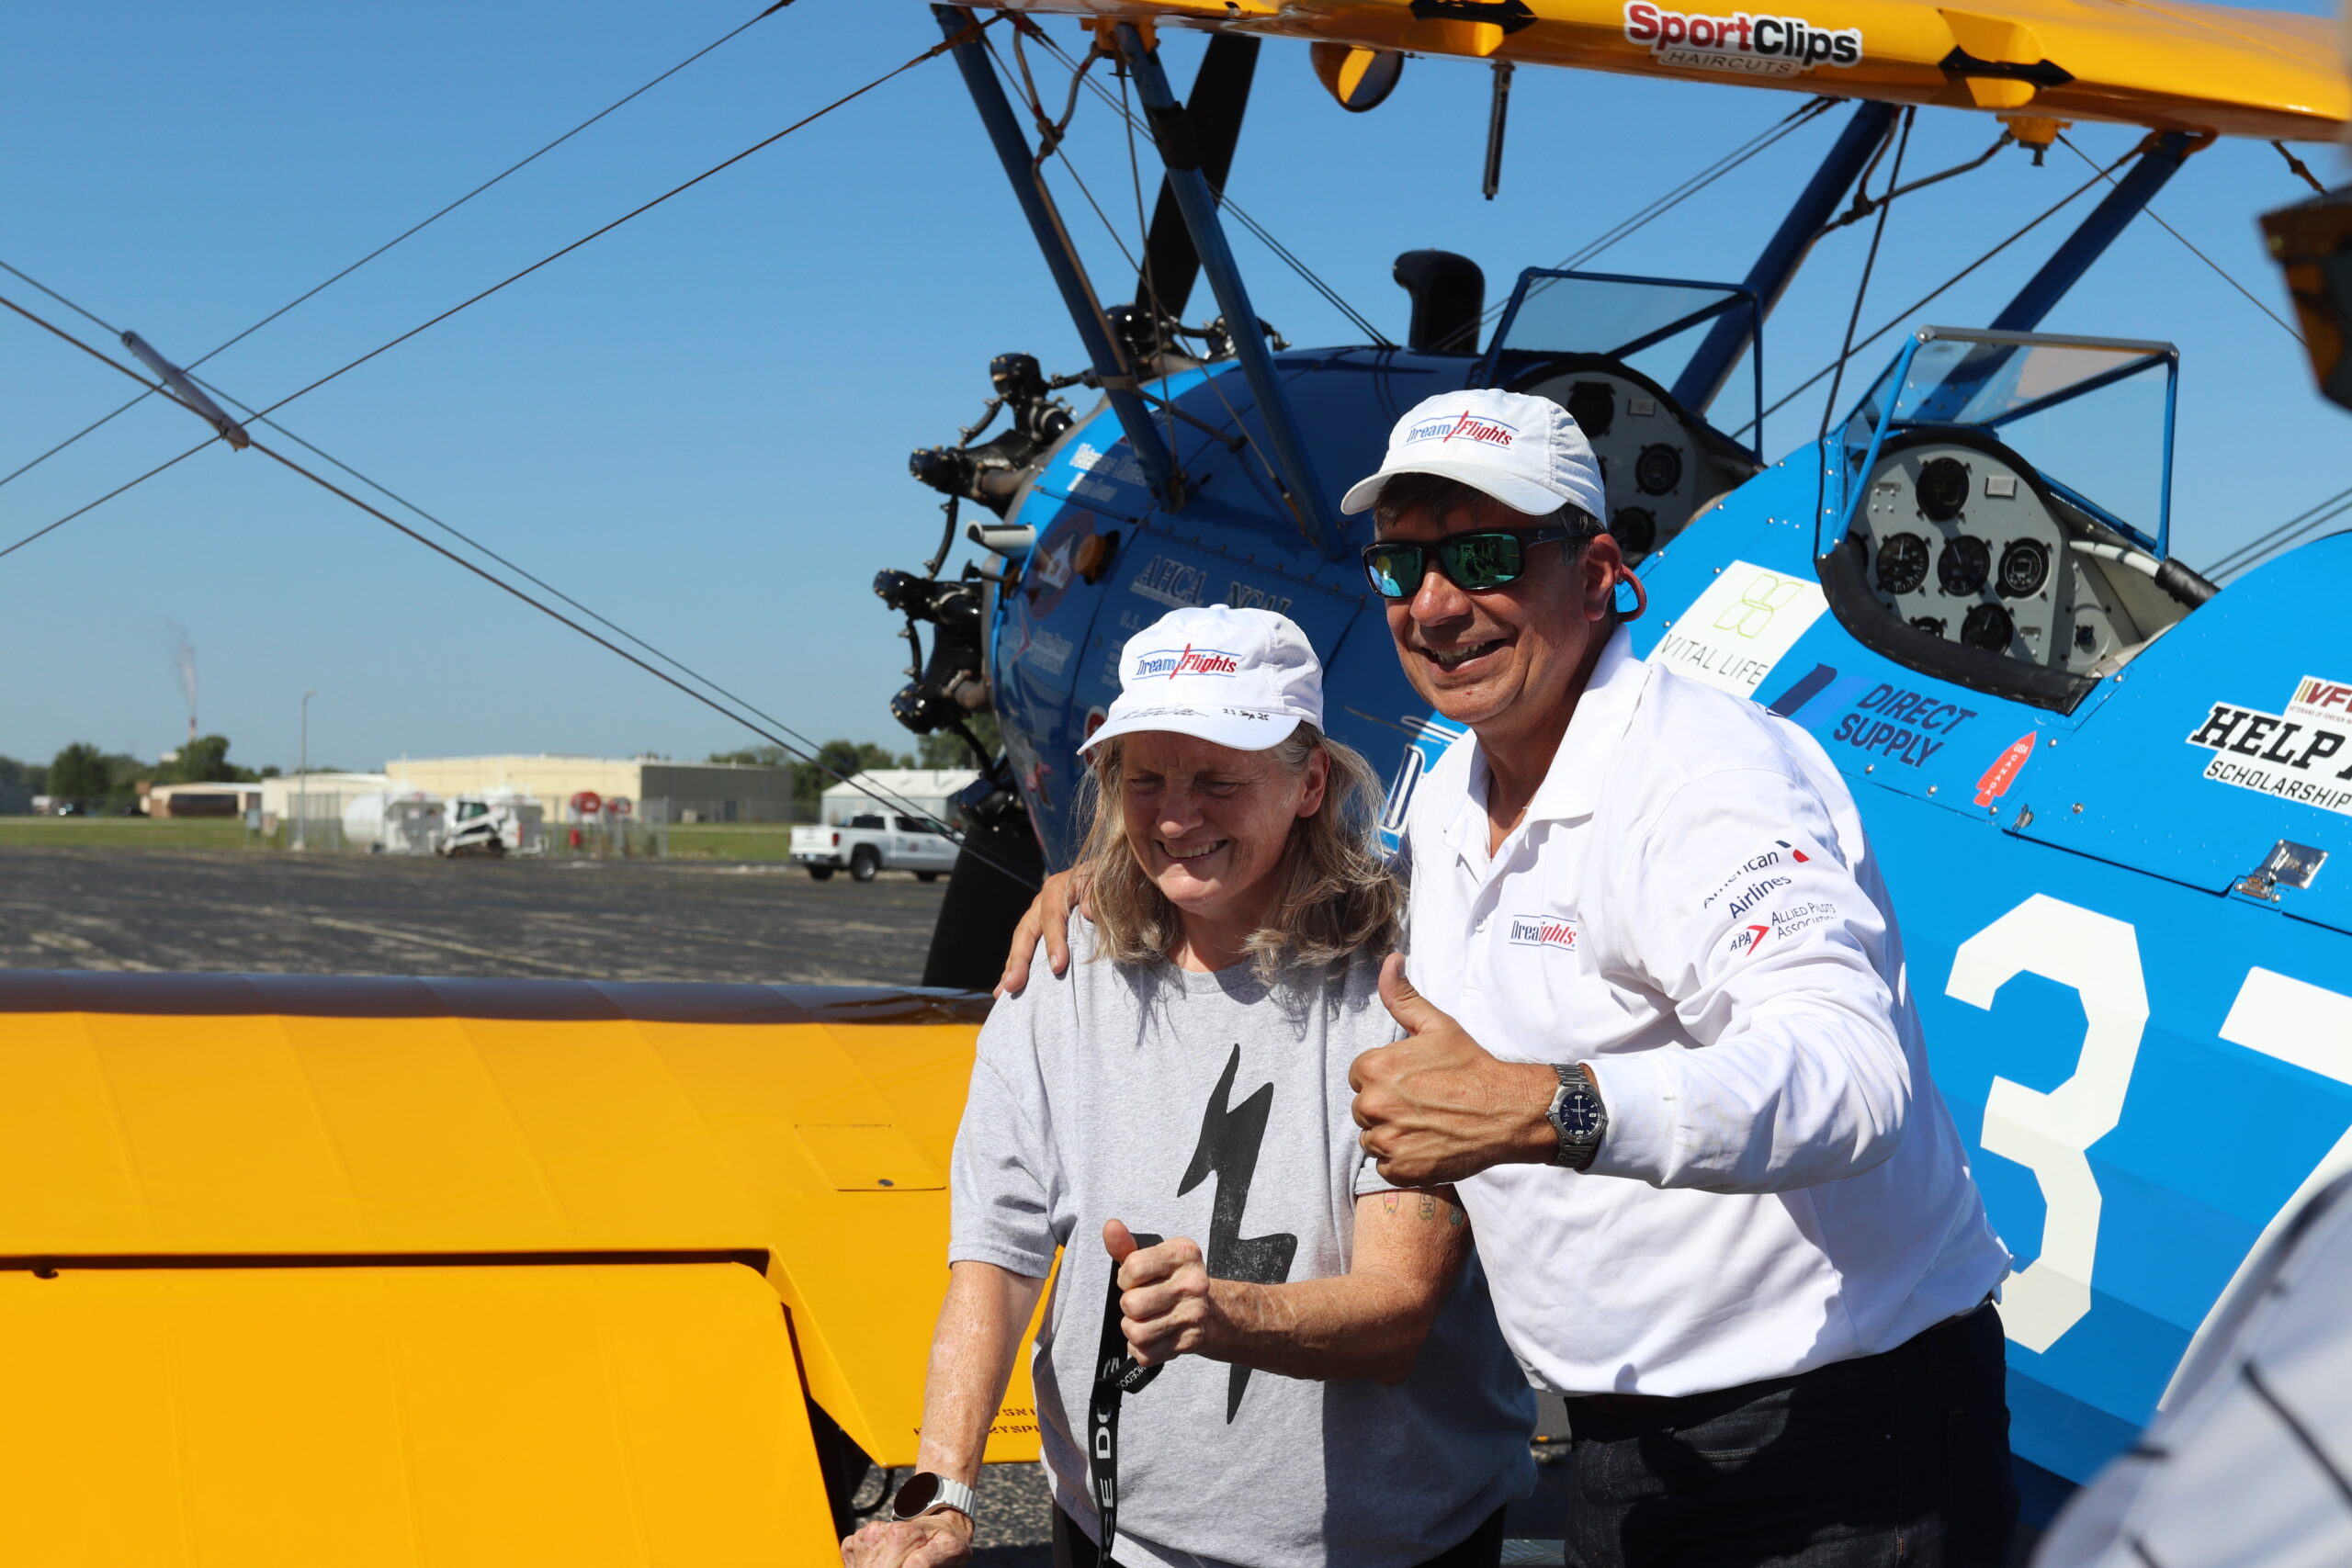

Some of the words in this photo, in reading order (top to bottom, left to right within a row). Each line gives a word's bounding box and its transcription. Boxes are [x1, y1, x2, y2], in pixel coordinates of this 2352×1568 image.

[1668, 51, 1792, 74] HAIRCUTS
[1407, 423, 1452, 442] Dream
[1456, 420, 1513, 446] Flights
[1134, 555, 1207, 606] AHCA
[1136, 658, 1177, 676] Dream
[1180, 653, 1238, 673] Flights
[1661, 634, 1712, 670] VITAL
[1718, 653, 1770, 685] LIFE
[1857, 682, 1979, 736] DIRECT
[1833, 713, 1944, 769] SUPPLY
[2013, 742, 2029, 755] USA
[2190, 705, 2346, 770] HELP
[1984, 754, 2018, 796] CANADA
[1728, 875, 1792, 919] Airlines
[1729, 931, 1752, 952] APA
